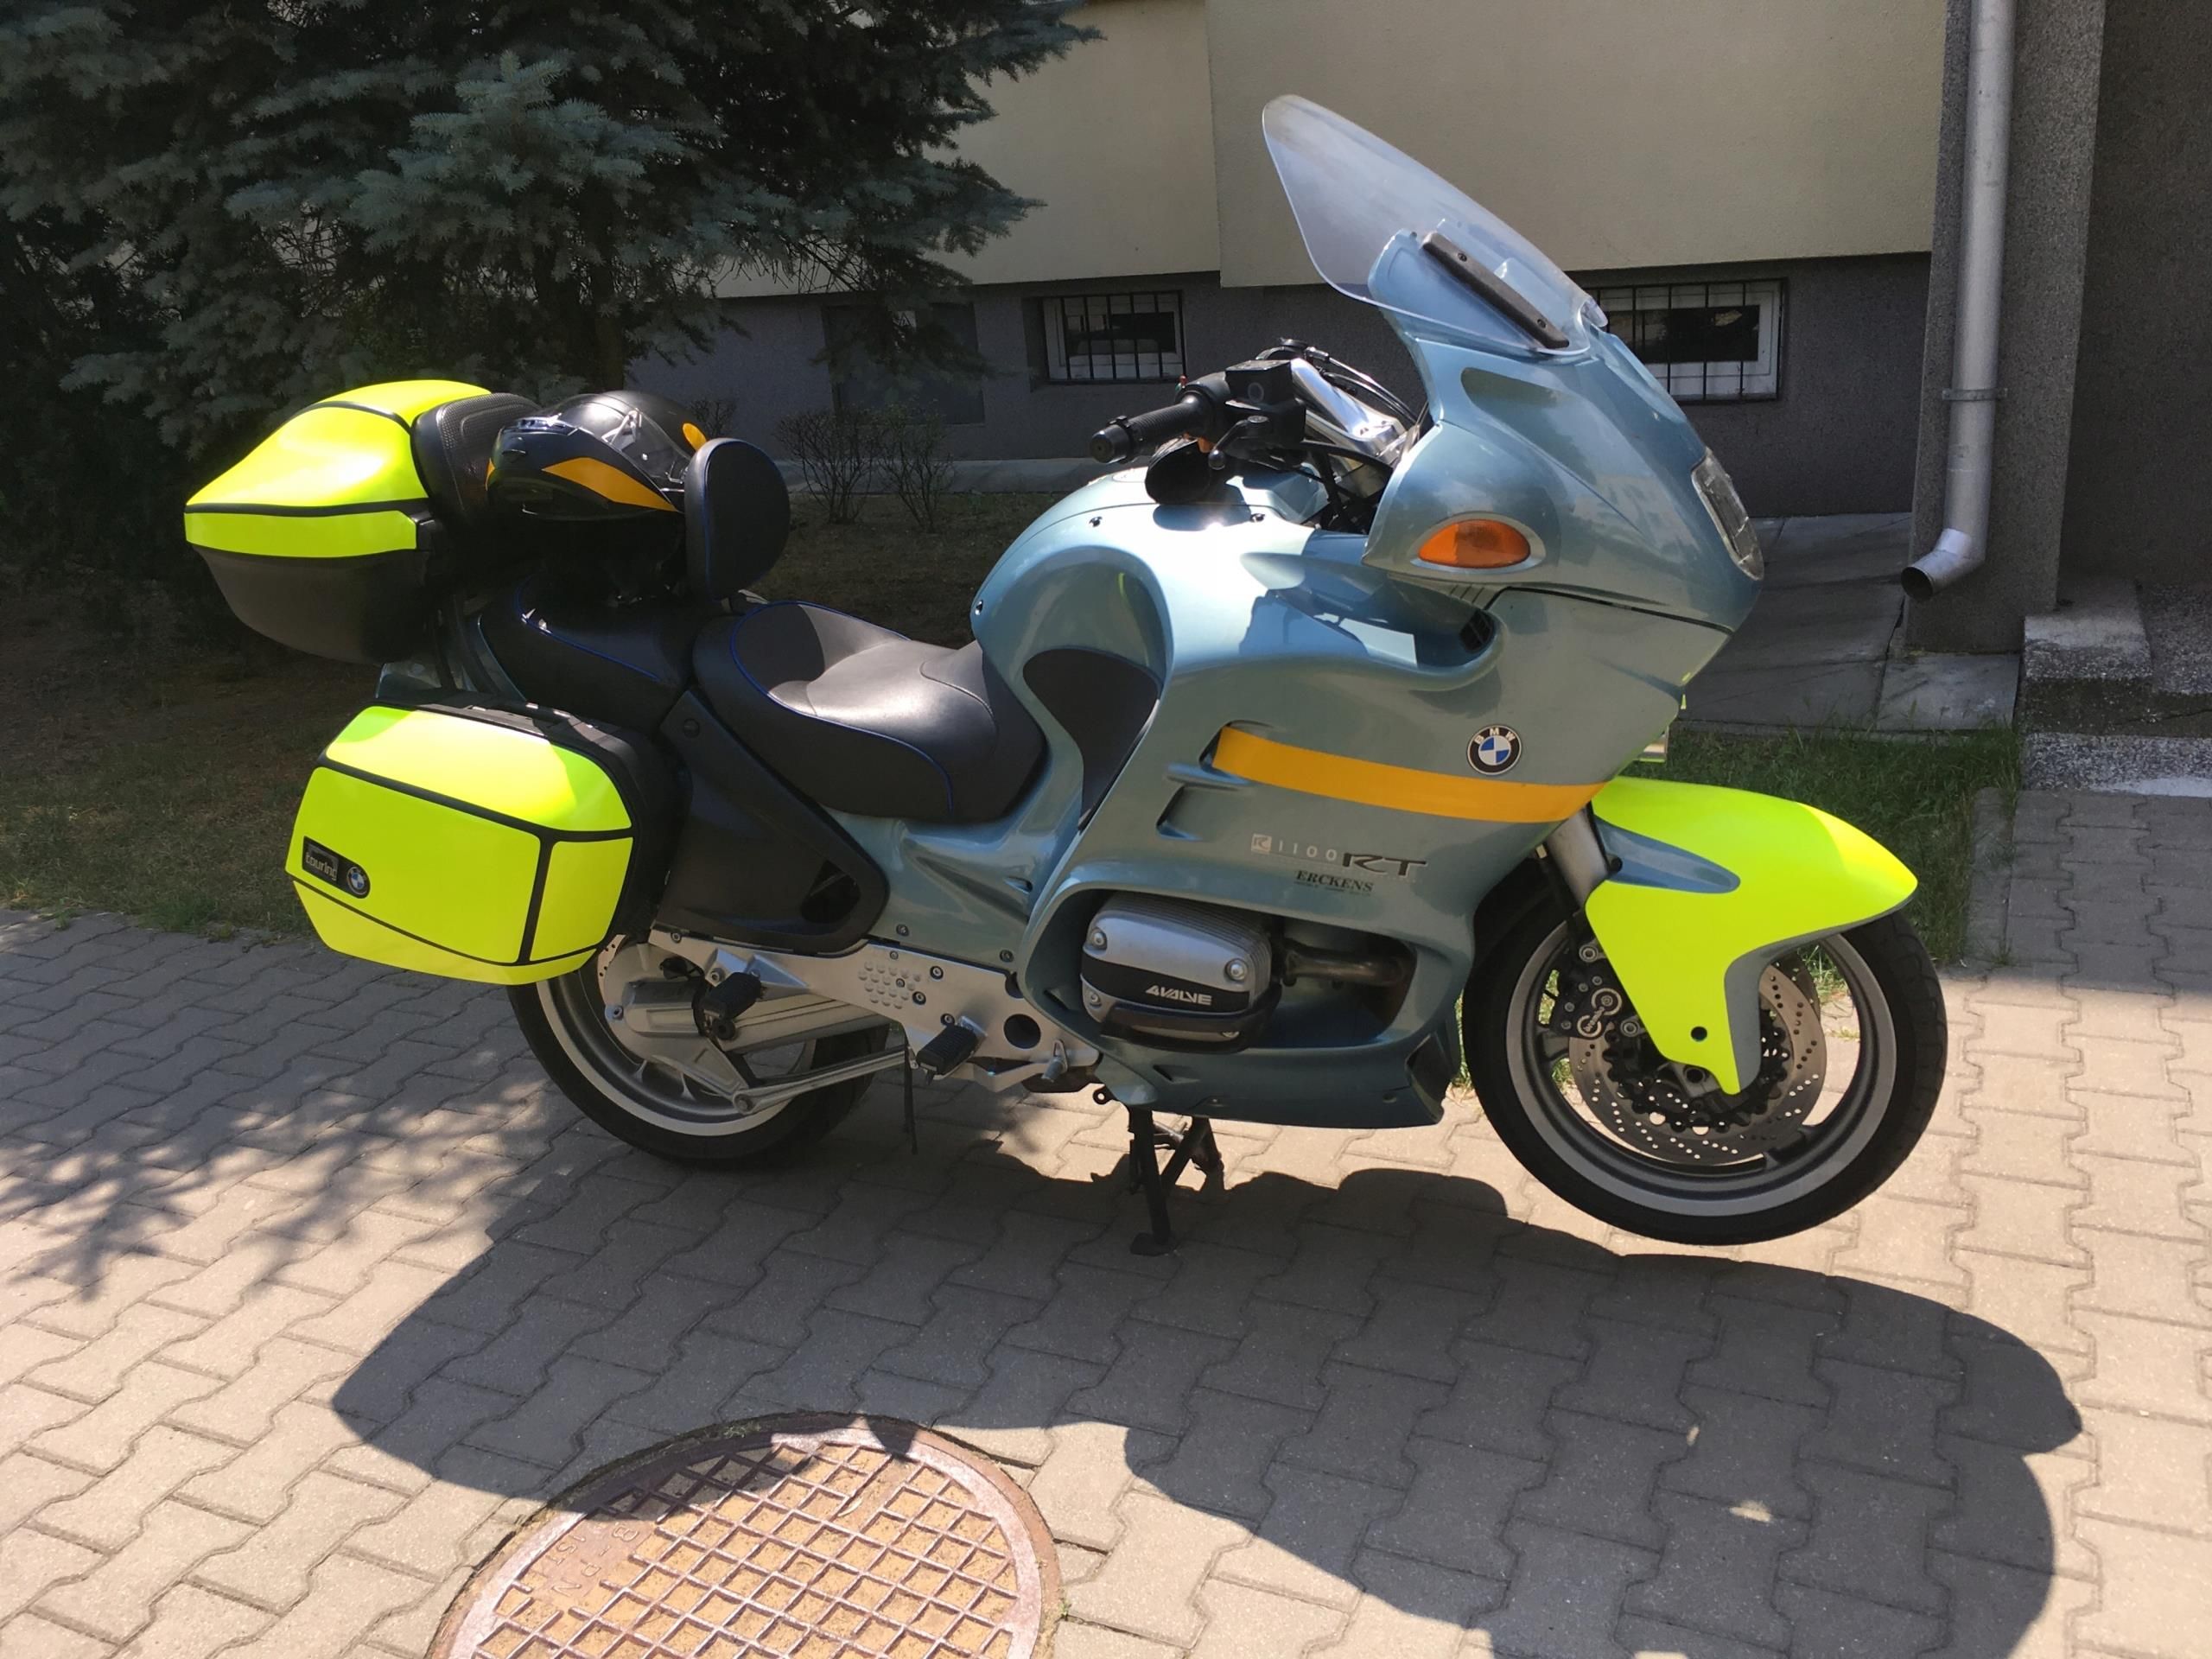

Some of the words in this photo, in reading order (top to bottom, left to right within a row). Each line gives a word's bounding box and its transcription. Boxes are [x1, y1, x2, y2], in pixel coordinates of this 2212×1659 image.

[1473, 727, 1516, 745] BMW
[1278, 840, 1338, 861] 1100
[1342, 852, 1427, 877] RT
[1295, 869, 1375, 893] ERCKENS
